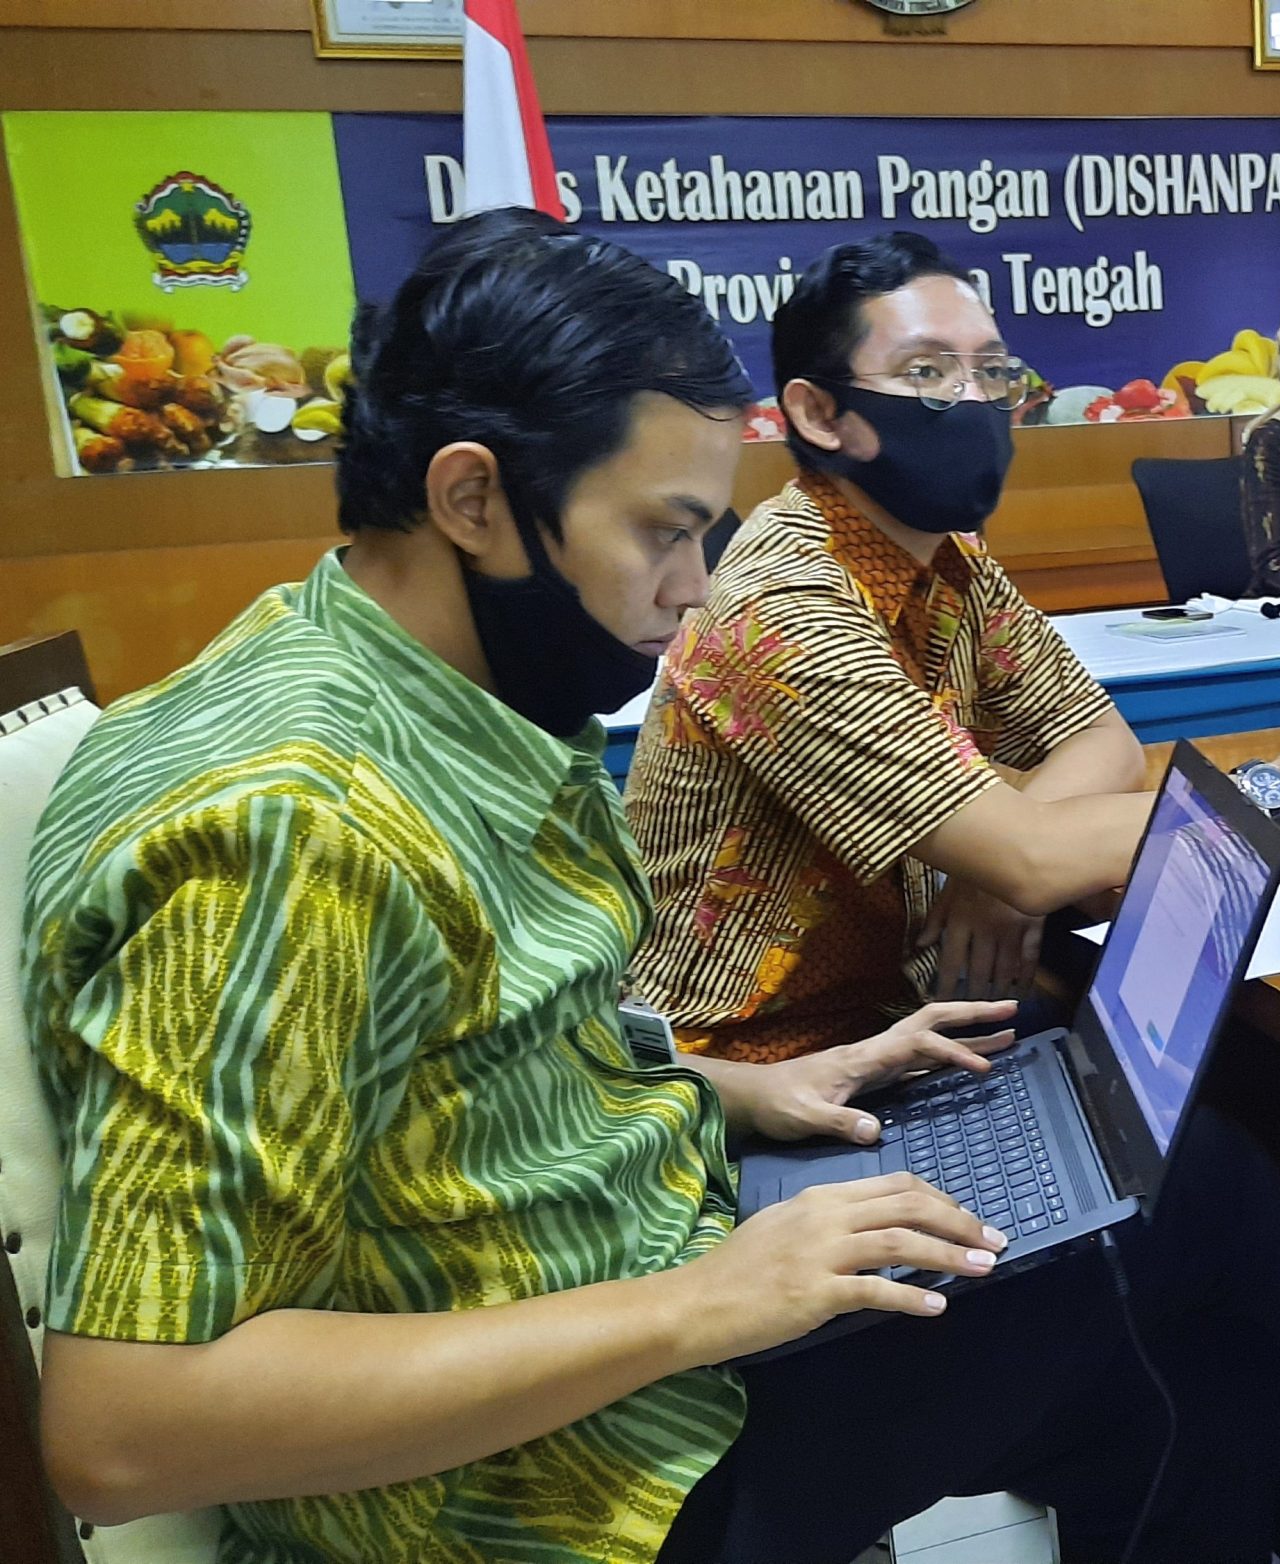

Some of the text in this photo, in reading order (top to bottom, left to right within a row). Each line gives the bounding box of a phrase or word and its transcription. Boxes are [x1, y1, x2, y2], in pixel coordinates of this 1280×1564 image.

[595, 155, 863, 222] Ketahanan
[878, 155, 1049, 232] Pangan
[667, 256, 803, 324] Provi
[1002, 251, 1163, 327] Tengah
